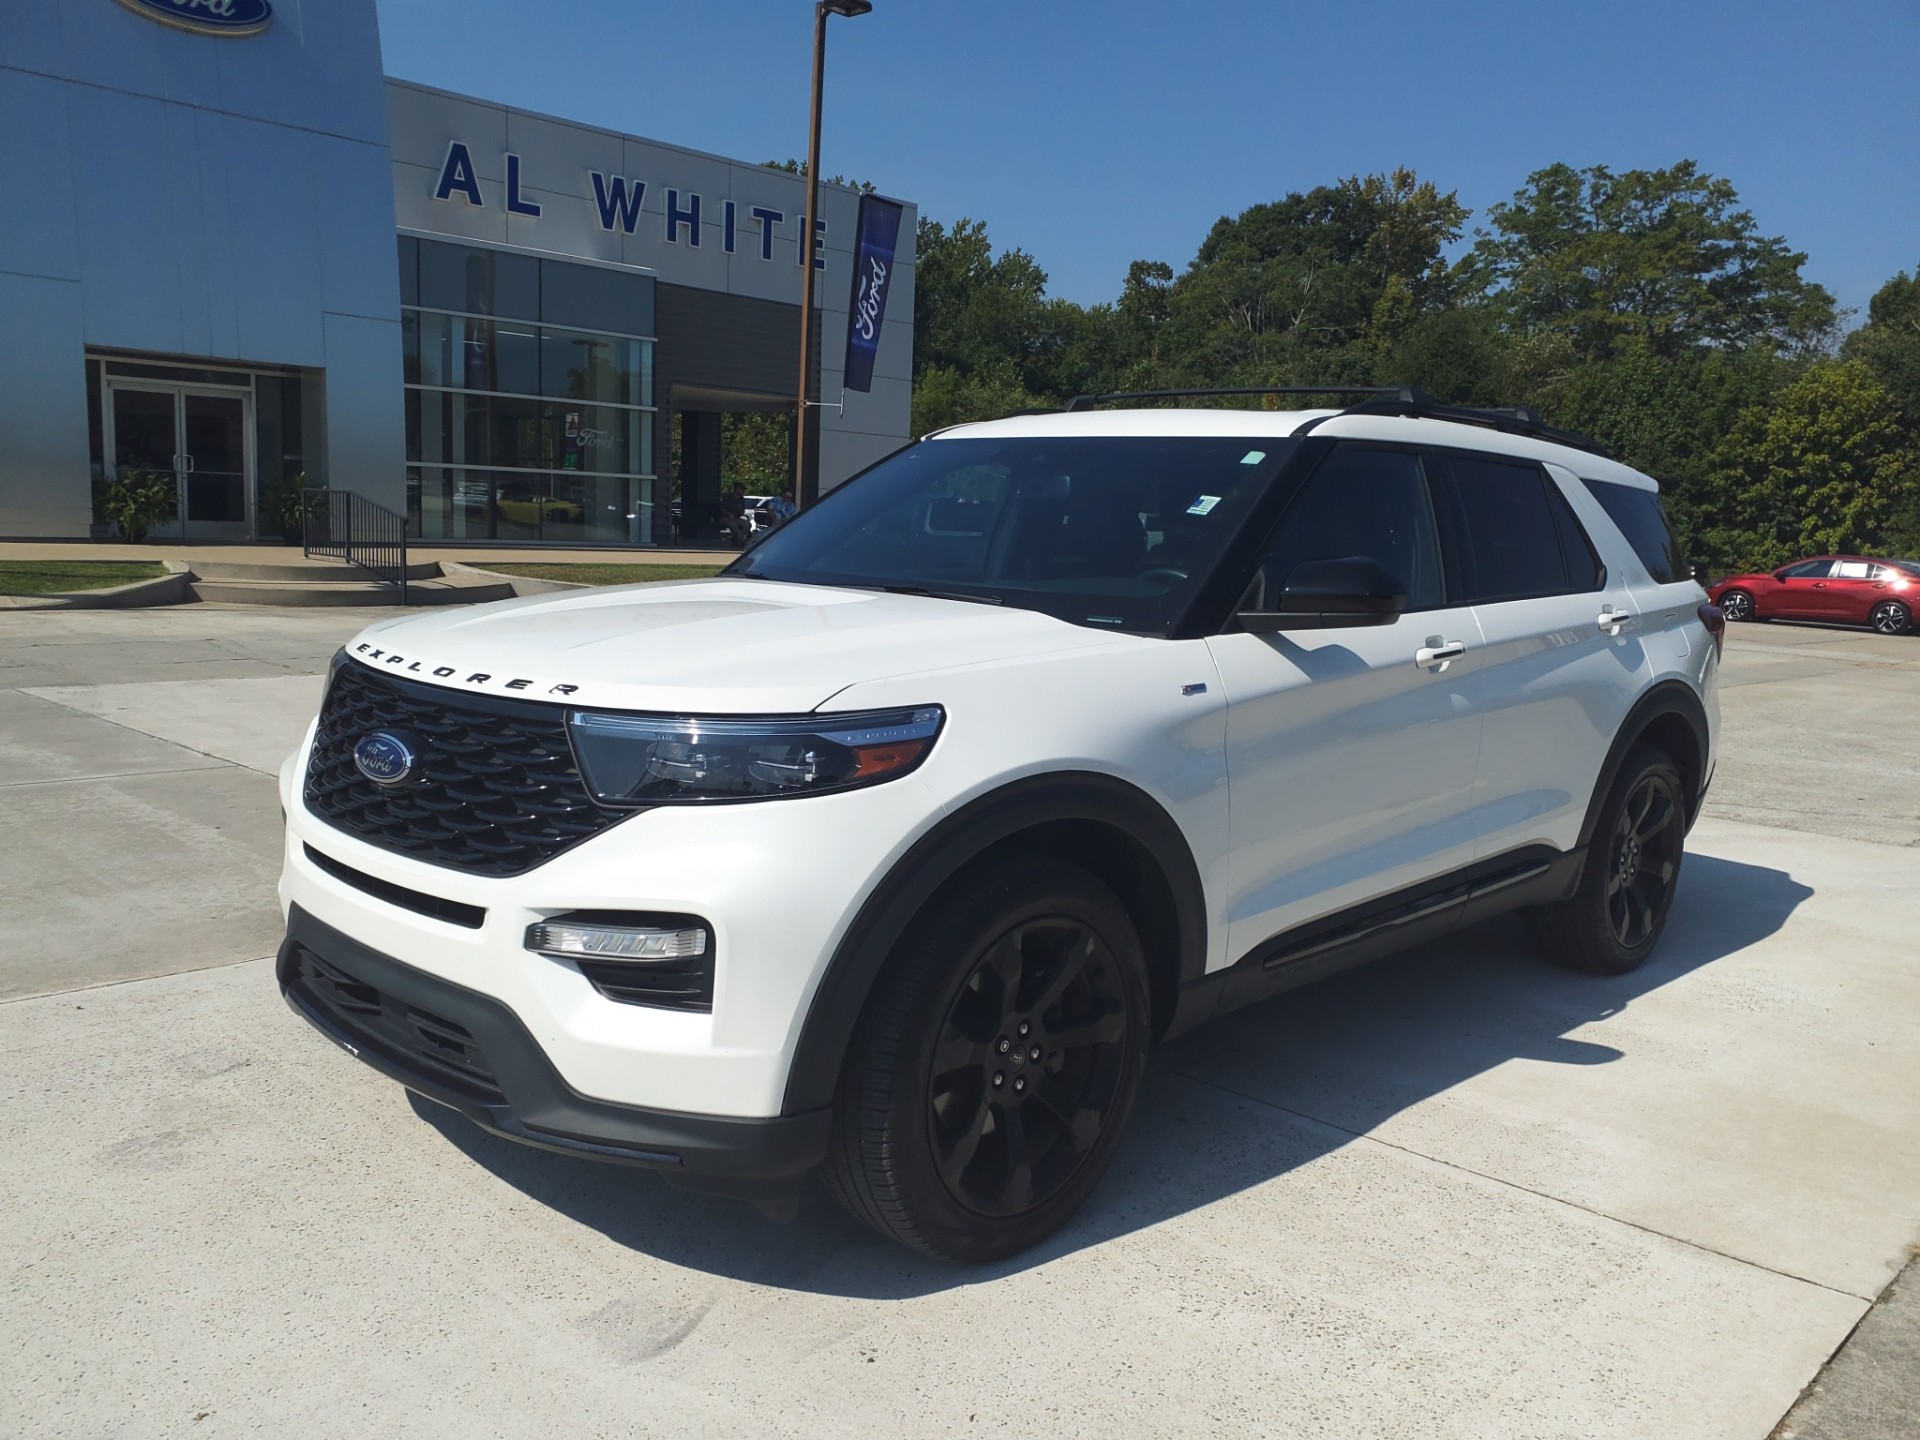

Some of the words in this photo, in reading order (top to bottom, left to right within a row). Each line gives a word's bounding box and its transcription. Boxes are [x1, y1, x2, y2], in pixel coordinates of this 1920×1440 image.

[434, 140, 542, 218] AL
[587, 169, 827, 271] WHITE
[855, 255, 887, 341] Ford
[576, 428, 615, 448] Ford
[356, 642, 580, 697] EXPLORER
[361, 742, 395, 773] Ford
